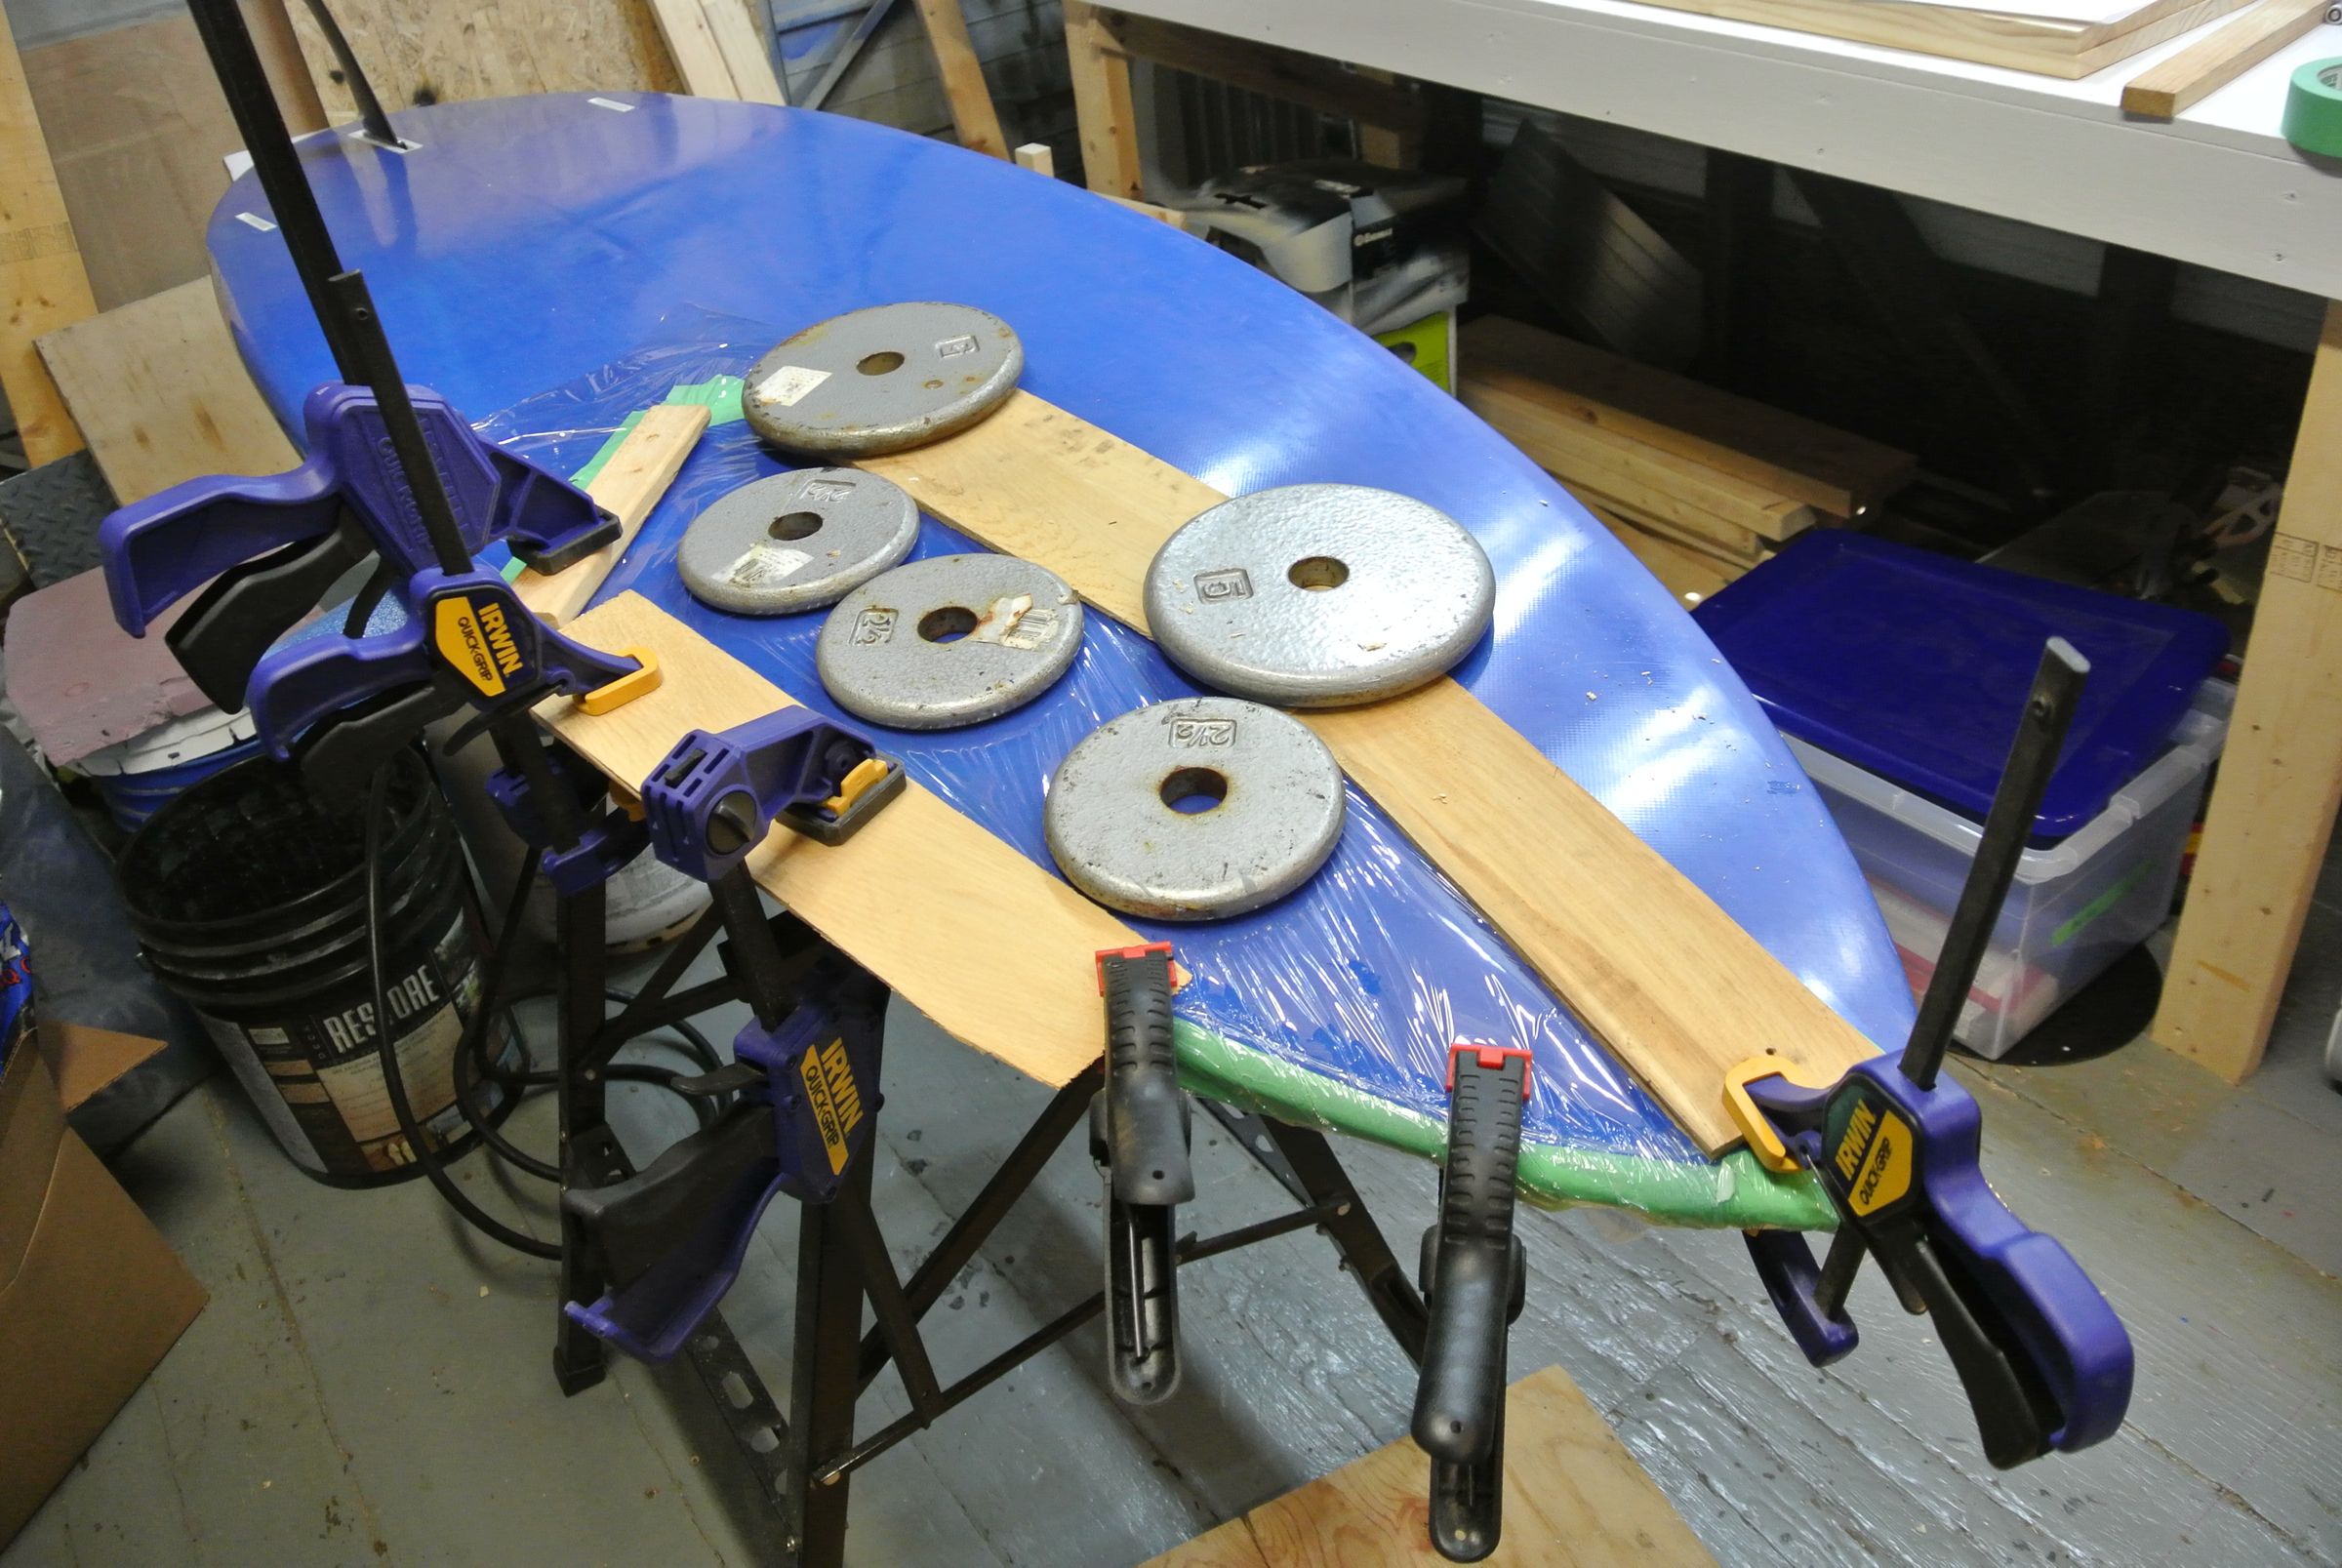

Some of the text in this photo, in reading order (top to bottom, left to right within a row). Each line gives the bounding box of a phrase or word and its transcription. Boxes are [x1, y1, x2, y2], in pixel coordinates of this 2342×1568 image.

[477, 602, 524, 677] IRWIN
[323, 964, 440, 1054] RESORE
[821, 1036, 865, 1137] IRWIN
[1836, 1097, 1877, 1182] IRWIN
